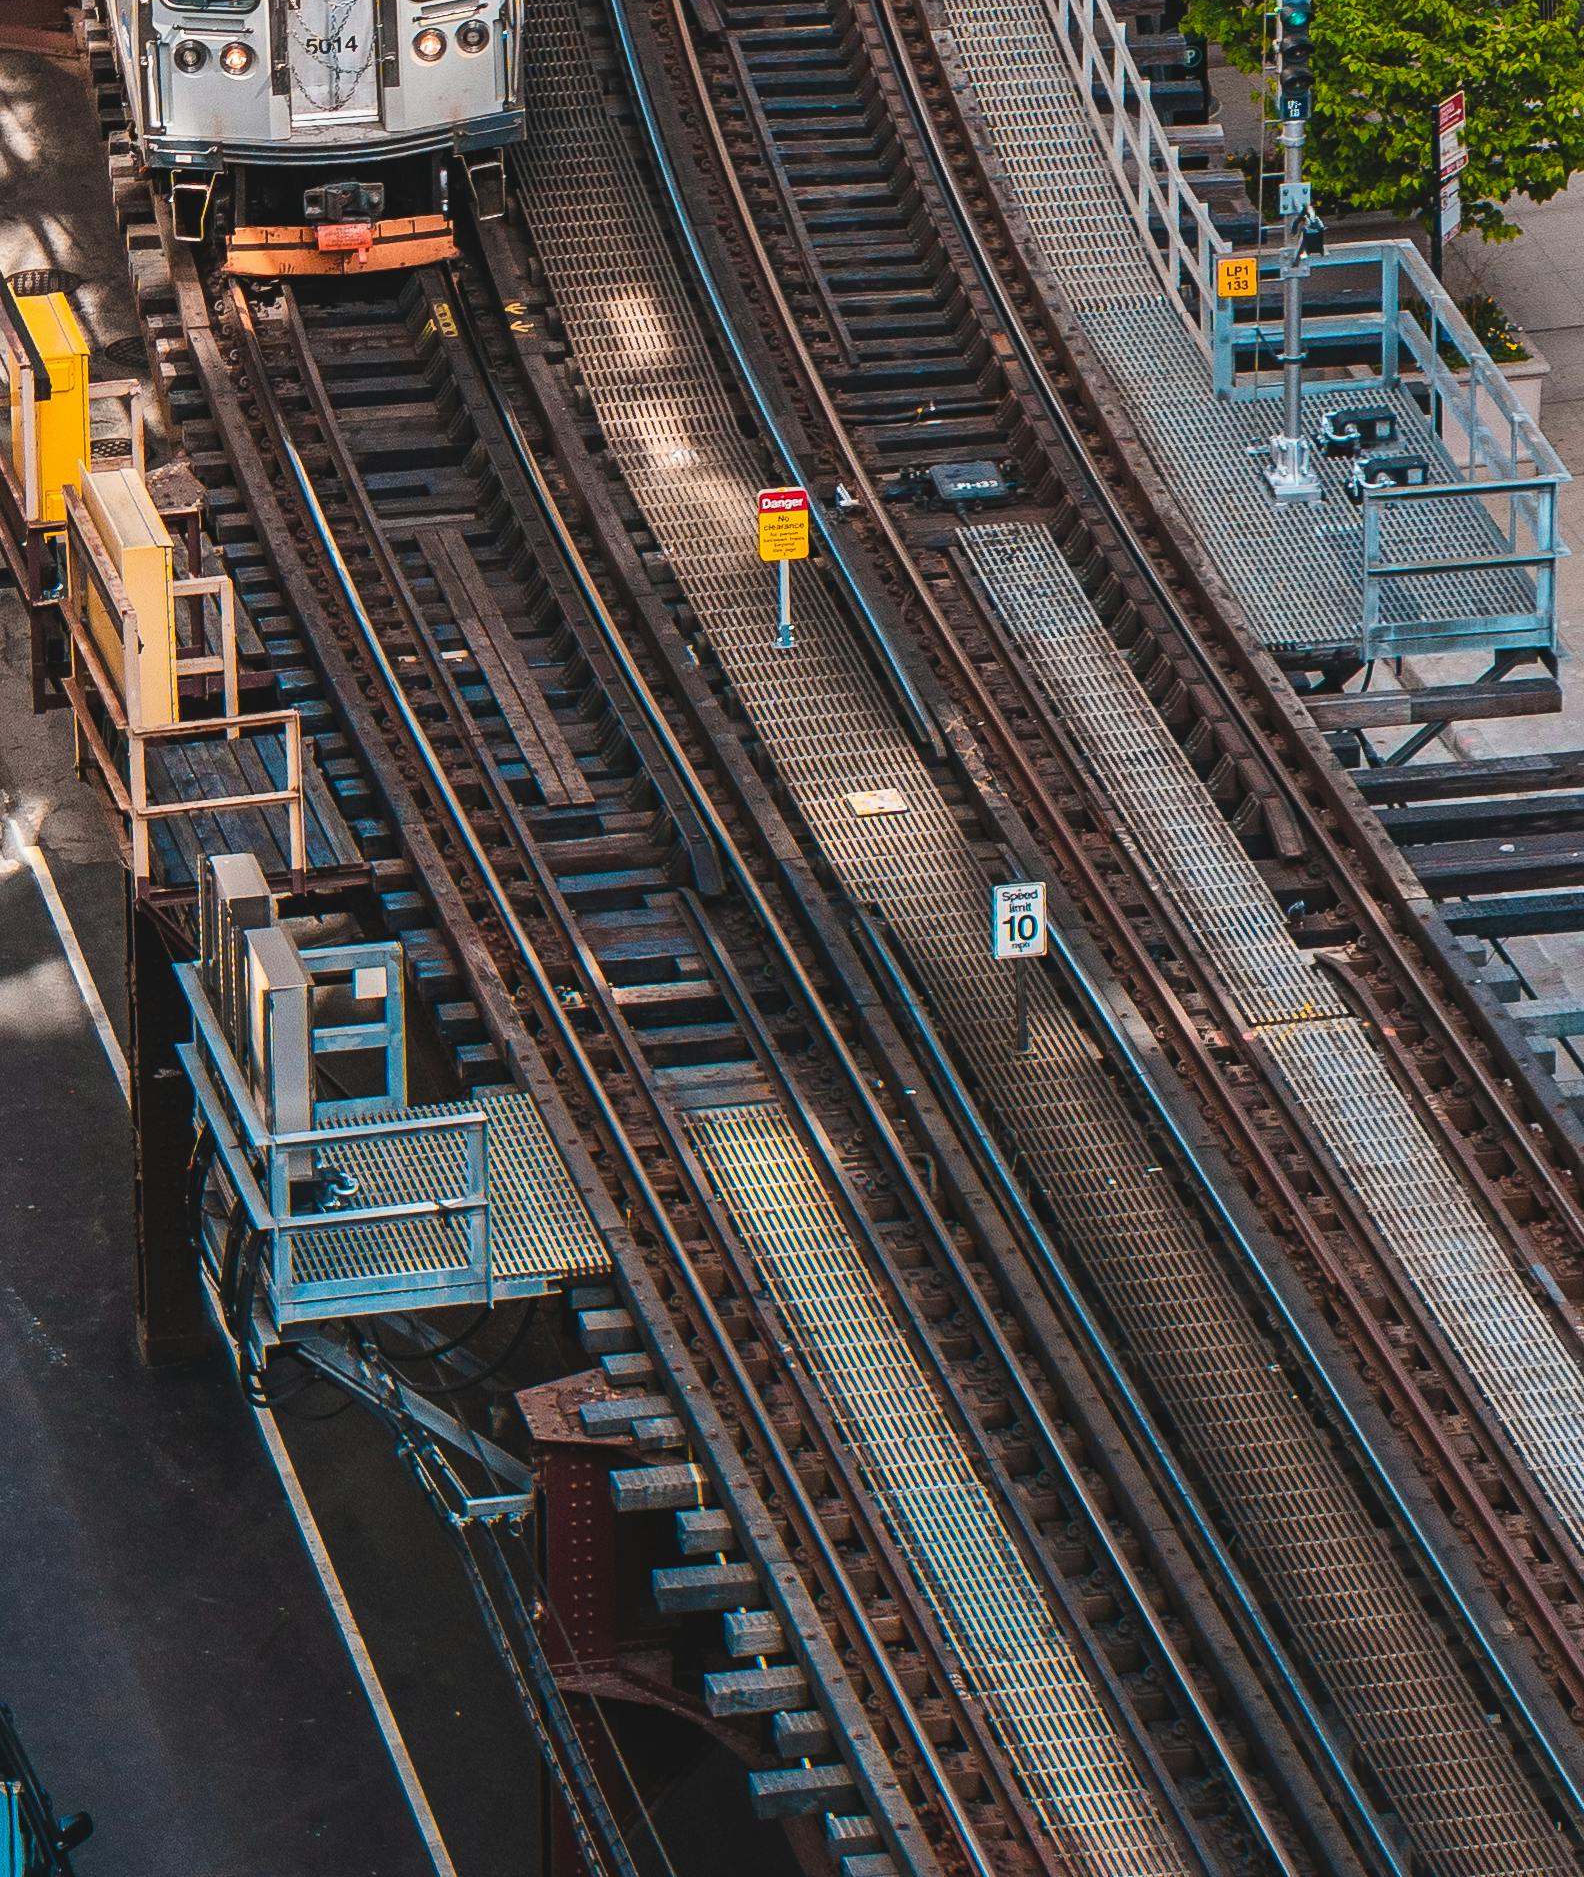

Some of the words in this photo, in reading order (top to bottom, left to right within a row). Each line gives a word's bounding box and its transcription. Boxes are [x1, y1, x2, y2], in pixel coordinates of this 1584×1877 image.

[306, 35, 358, 55] 5014
[1226, 265, 1248, 277] LP1
[1227, 279, 1249, 291] 133
[761, 497, 803, 509] Danger
[777, 515, 790, 523] No
[763, 522, 805, 531] clearance
[1002, 888, 1039, 902] Speed
[1009, 902, 1032, 913] limit
[1002, 914, 1039, 942] 10
[1011, 942, 1031, 950] mph
